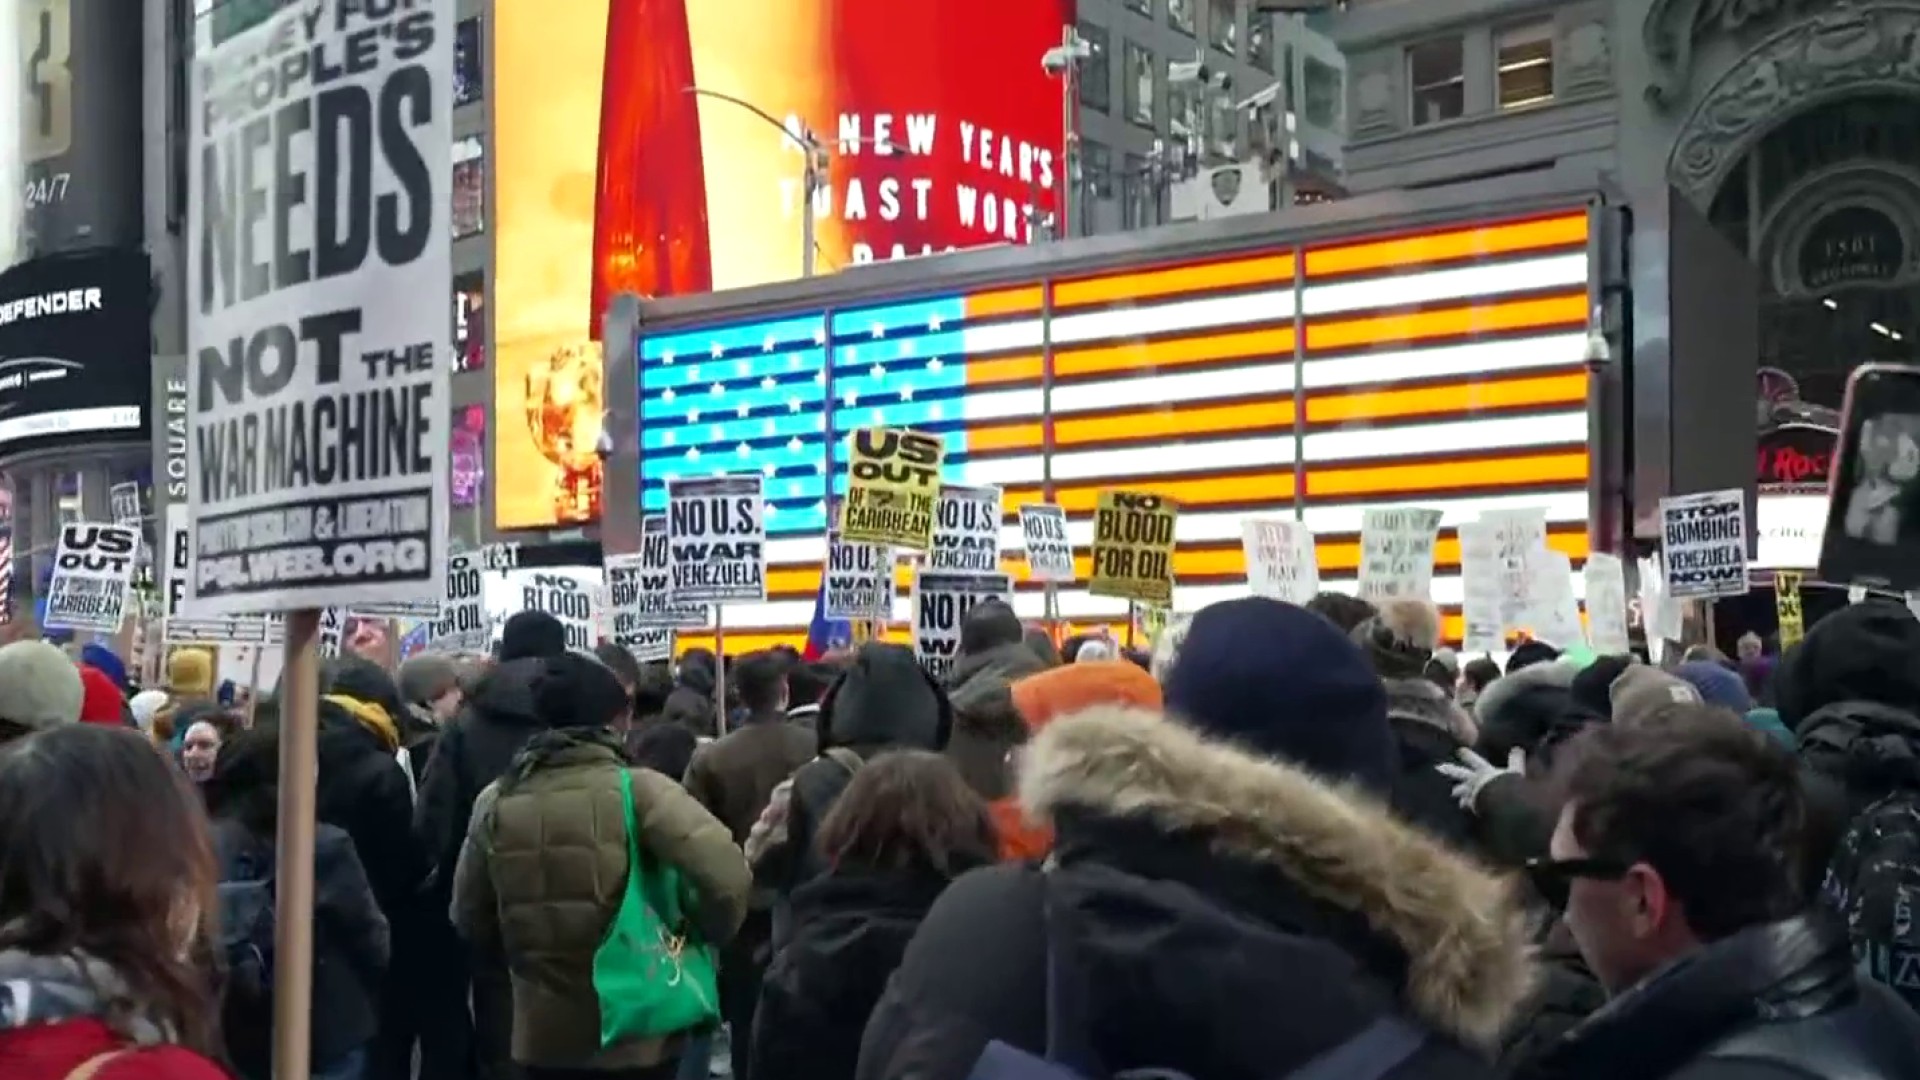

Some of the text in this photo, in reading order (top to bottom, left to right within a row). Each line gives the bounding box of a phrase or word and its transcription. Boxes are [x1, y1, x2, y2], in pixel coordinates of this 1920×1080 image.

[838, 113, 936, 155] NEW
[959, 120, 1053, 188] YEAR'S
[25, 173, 71, 209] 24/7
[200, 64, 433, 316] NEEDS
[778, 178, 1054, 244] TOAST WORT
[198, 307, 433, 413] NOT THE
[168, 380, 186, 497] SQUARE
[198, 383, 432, 503] WAR MACHINE
[856, 429, 938, 465] US
[853, 462, 937, 487] OUT
[849, 487, 864, 506] OF
[910, 493, 931, 513] THE
[1114, 492, 1162, 510] NO
[1666, 502, 1740, 521] STOP
[671, 498, 760, 537] NO U.S.
[846, 505, 930, 536] CARIBBEAN
[936, 499, 997, 533] NO U.S.
[1023, 516, 1043, 538] NO
[1099, 509, 1173, 544] BLOOD
[64, 527, 133, 553] US
[933, 534, 995, 552] WAR
[1667, 517, 1740, 545] BOMBING
[59, 554, 130, 573] OUT
[198, 538, 427, 591] PSLWEB.ORG
[643, 534, 668, 569] NO
[672, 542, 760, 561] WAR
[830, 545, 891, 572] NO U..
[931, 549, 995, 570] VENEZUELA
[1094, 546, 1131, 577] FOR
[1138, 549, 1169, 579] OIL
[1668, 545, 1741, 569] VENEZUELA
[447, 568, 480, 600] OOD
[535, 574, 577, 590] NO
[672, 563, 760, 588] VENEZUELA
[1669, 567, 1741, 584] NOW!
[50, 593, 123, 616] CARIBBEAN
[458, 604, 482, 631] OIL
[524, 586, 590, 620] BLOOD
[921, 593, 953, 630] NO
